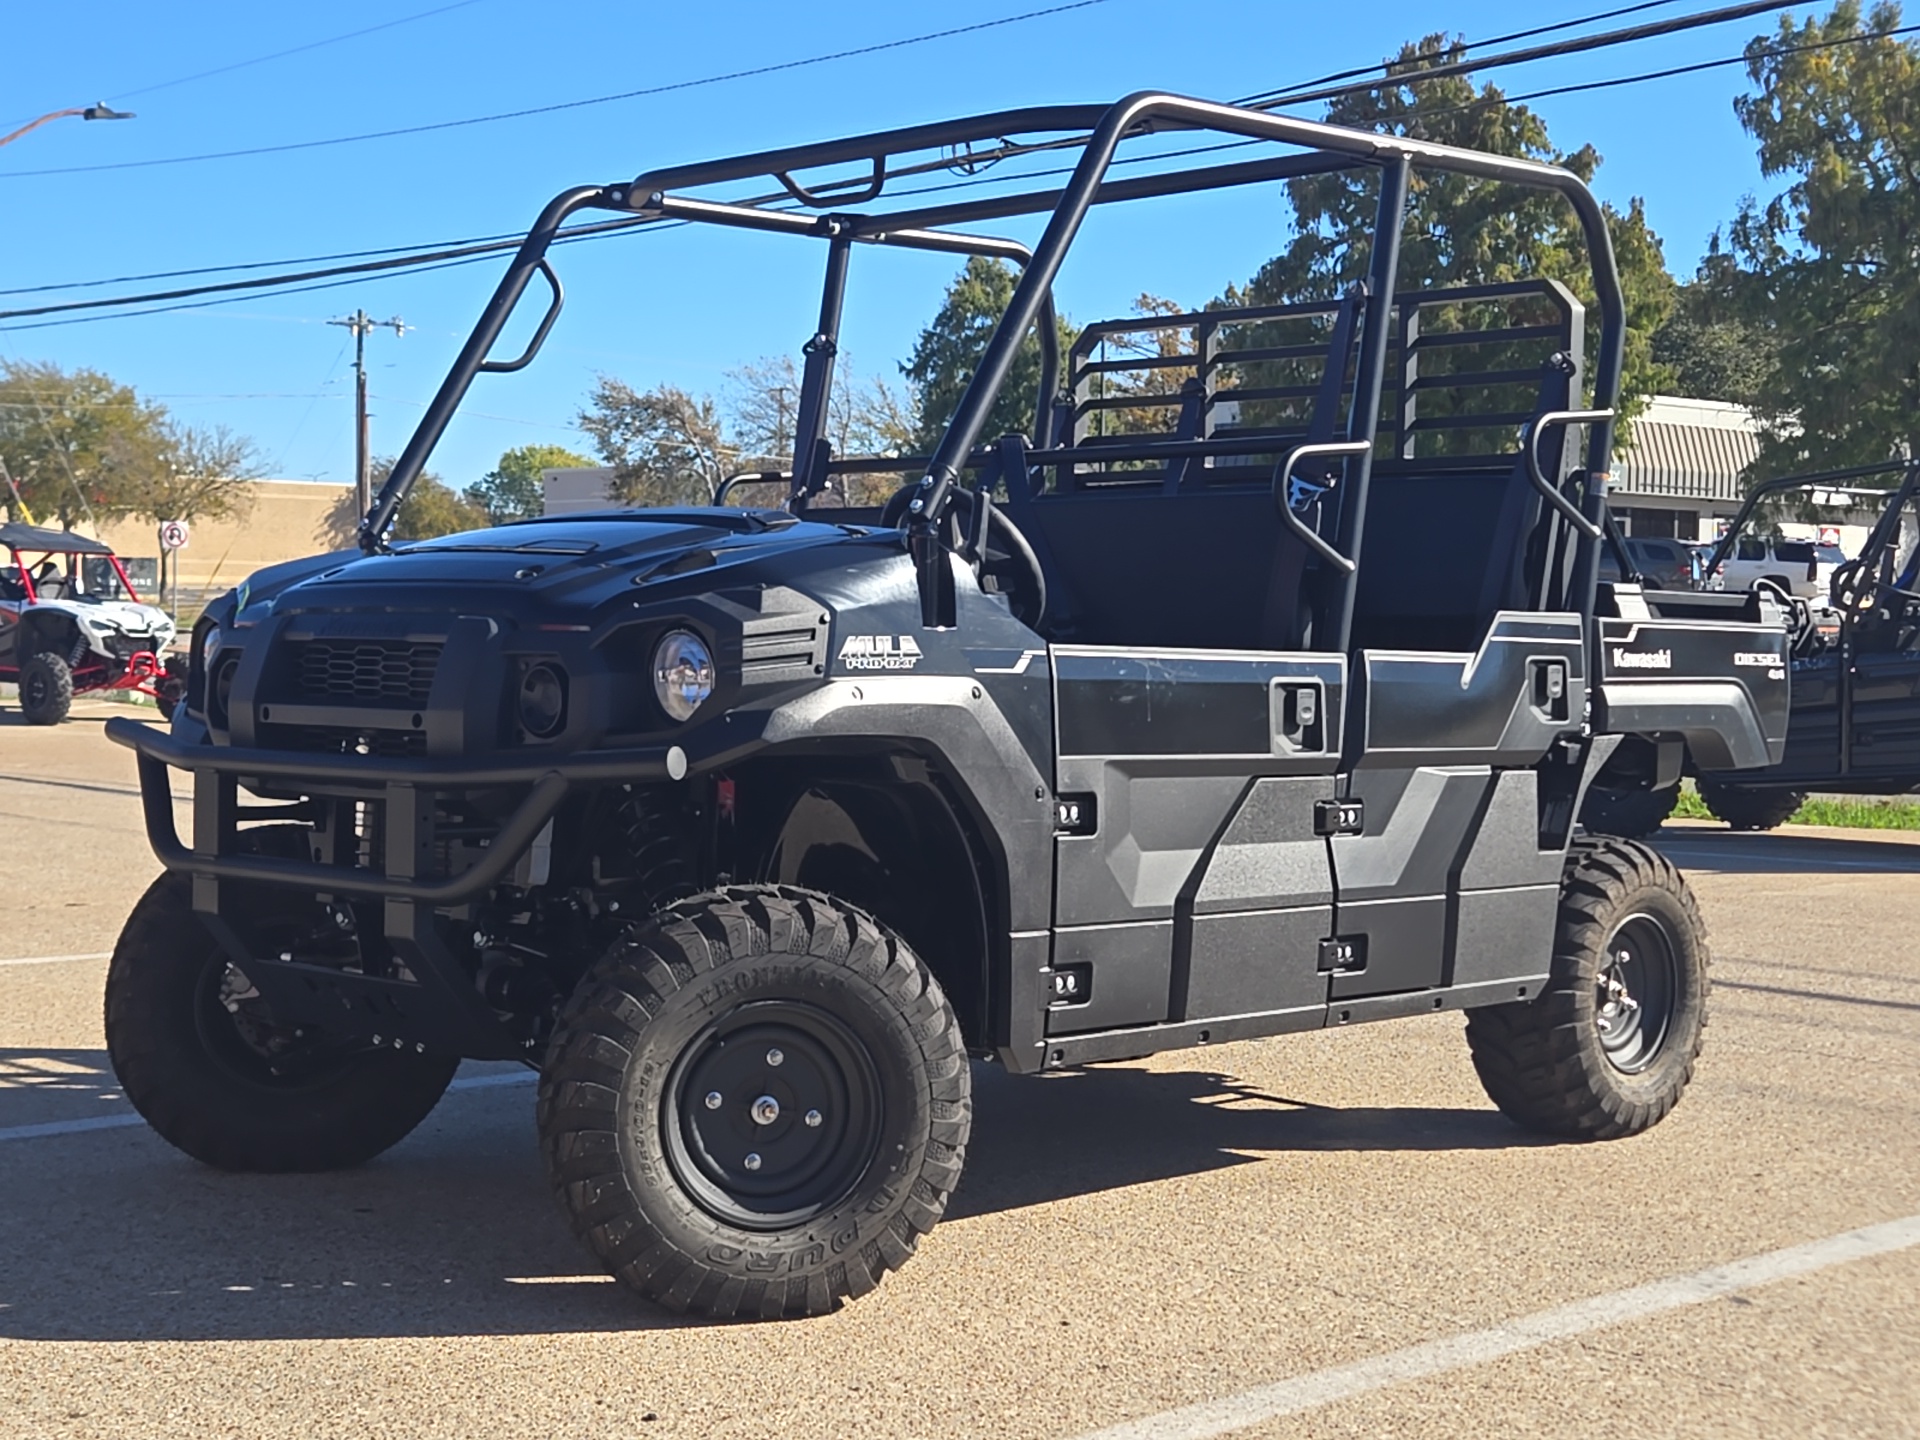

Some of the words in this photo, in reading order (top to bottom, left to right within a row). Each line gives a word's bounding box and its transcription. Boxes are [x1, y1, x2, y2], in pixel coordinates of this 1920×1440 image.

[837, 635, 924, 660] MULE
[1612, 647, 1672, 669] Kawasaki
[1733, 652, 1785, 667] DIESEL
[705, 1218, 861, 1275] DURO
